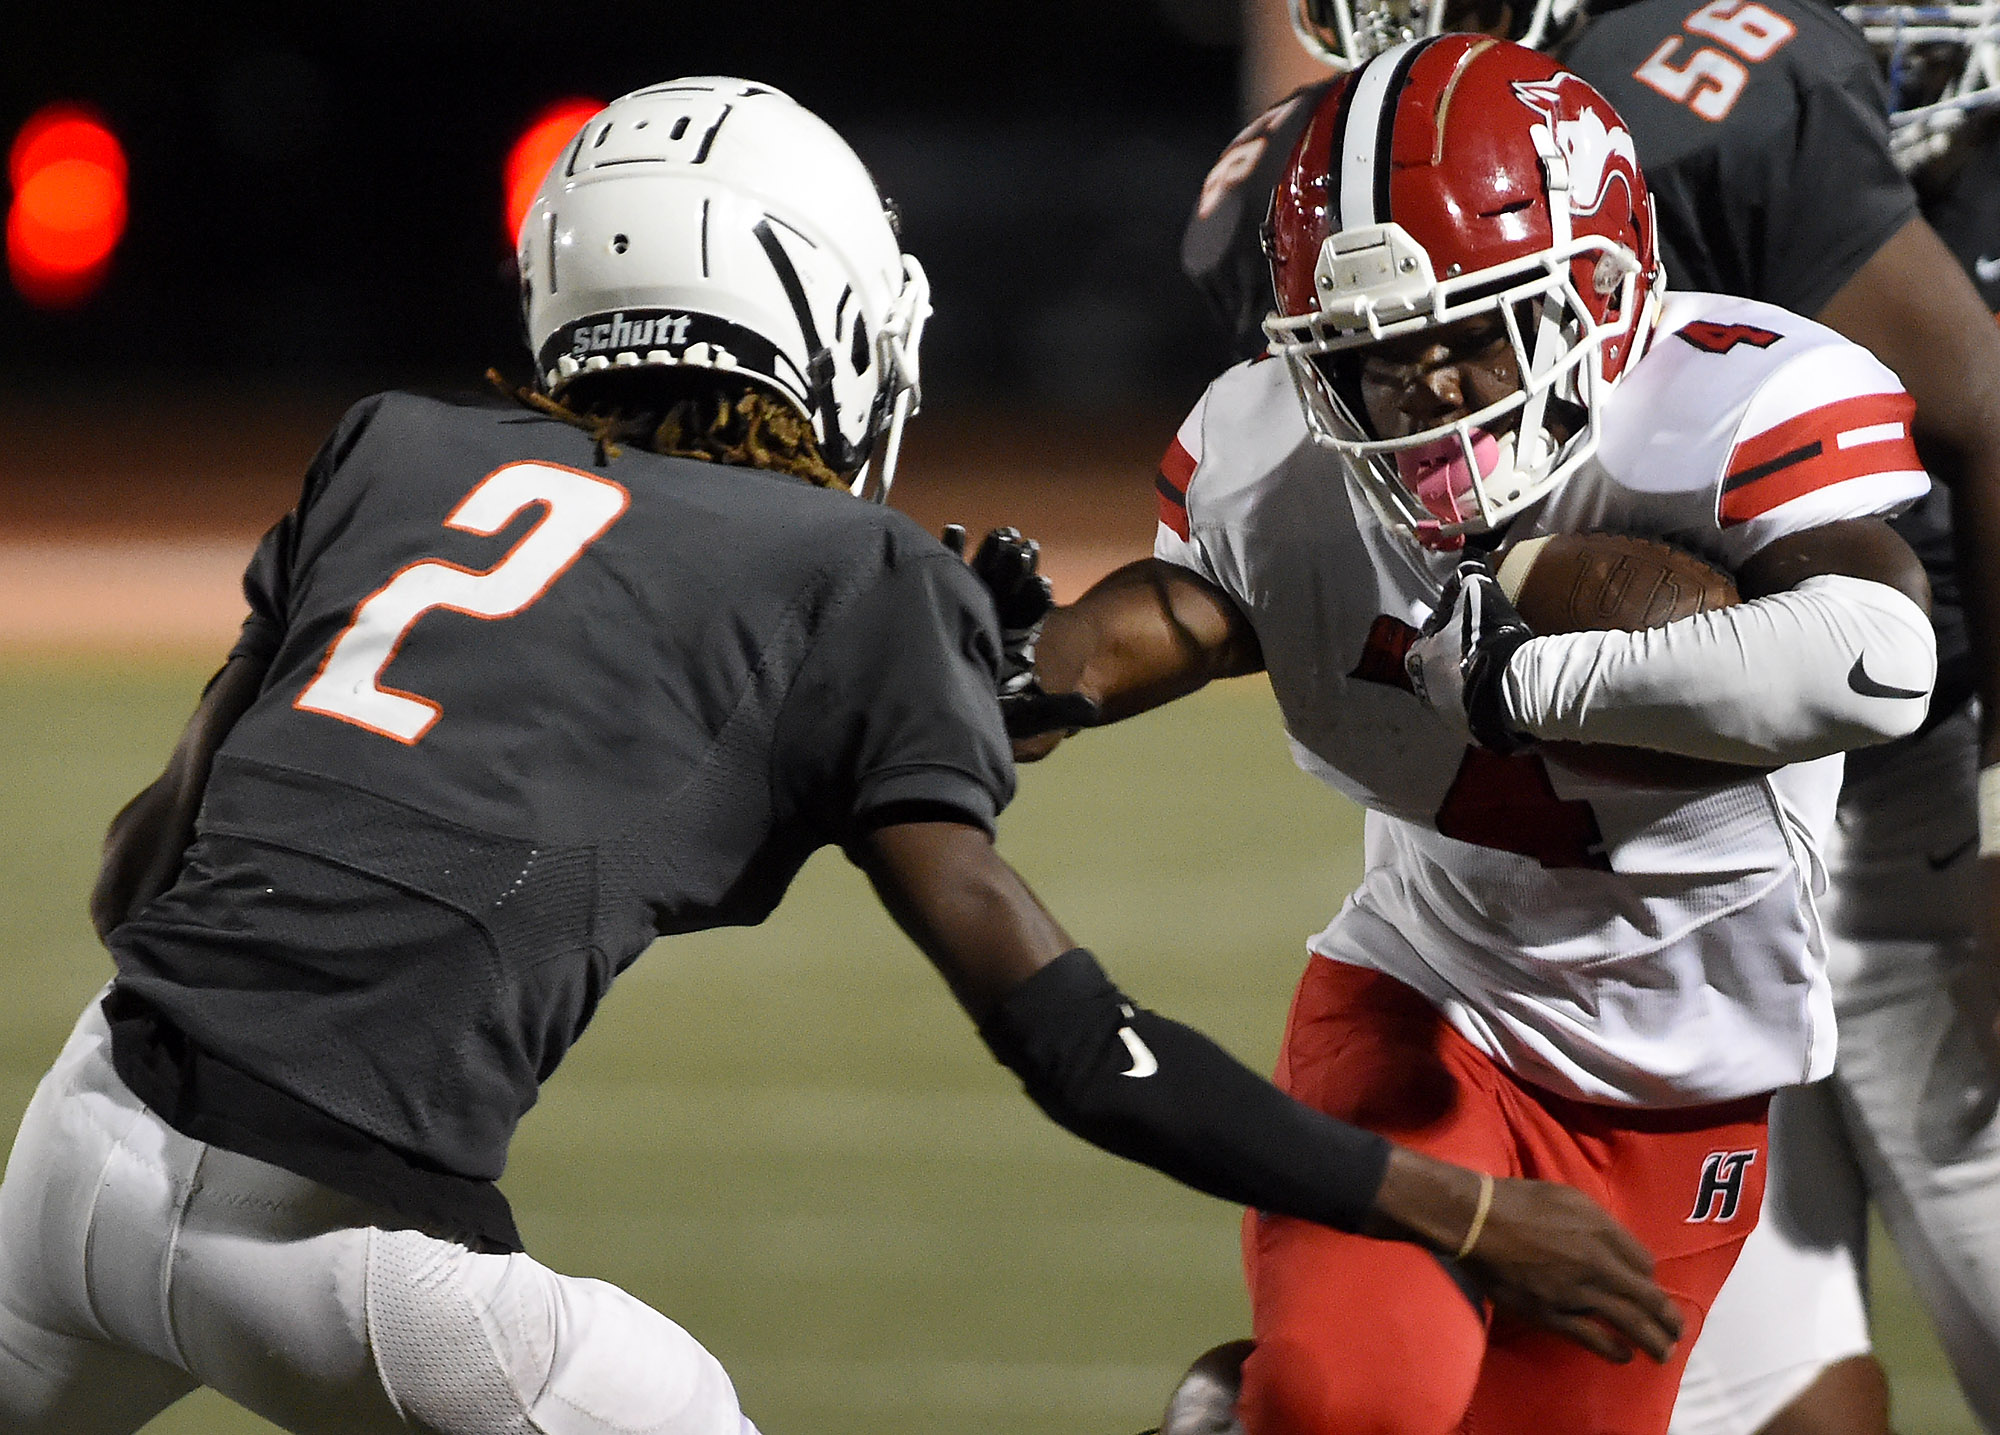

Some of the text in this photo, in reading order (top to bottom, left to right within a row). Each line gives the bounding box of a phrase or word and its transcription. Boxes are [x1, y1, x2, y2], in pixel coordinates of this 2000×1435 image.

[1632, 0, 1798, 123] 56
[572, 312, 691, 355] schutt
[1671, 319, 1785, 354] 4
[293, 458, 631, 746] 2
